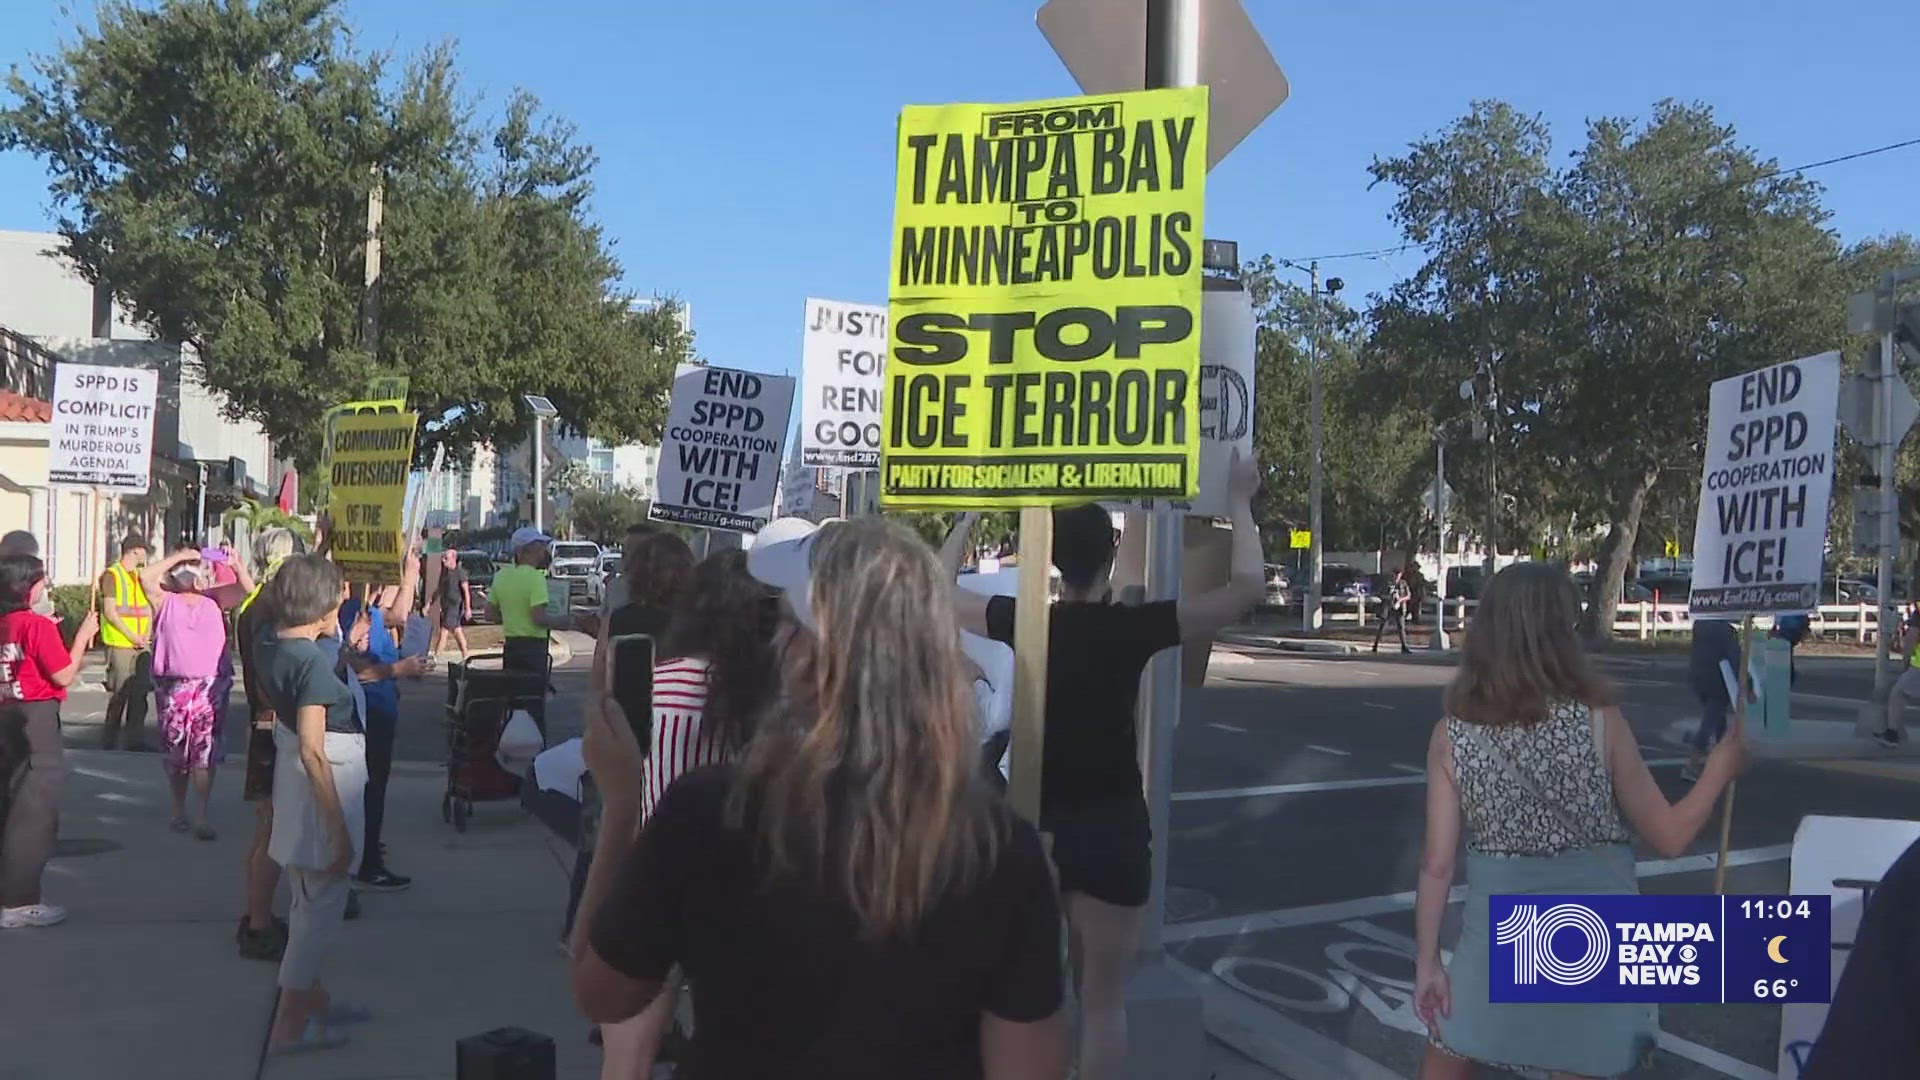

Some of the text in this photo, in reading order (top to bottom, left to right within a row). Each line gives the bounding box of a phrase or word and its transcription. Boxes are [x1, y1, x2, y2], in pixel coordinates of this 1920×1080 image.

[989, 107, 1114, 136] FROM
[908, 117, 1194, 205] TAMPA BAY
[1017, 200, 1078, 224] TO
[900, 211, 1192, 286] MINNEAPOLIS
[894, 305, 1193, 366] STOP
[75, 374, 138, 393] SPPD IS
[703, 370, 762, 400] END
[1740, 365, 1802, 413] END
[57, 399, 151, 420] COMPLICIT
[822, 385, 883, 413] REN
[890, 368, 1188, 449] ICE TERROR
[65, 423, 139, 438] IN TRUMP'S
[690, 400, 765, 432] SPPD
[59, 438, 142, 455] MURDEROUS
[335, 427, 413, 452] COMMUNITY
[670, 426, 778, 454] COOPERATION
[1727, 411, 1808, 462] SPPD
[69, 455, 129, 471] AGENDA!
[332, 459, 408, 487] OVERSIGHT
[678, 444, 760, 482] WITH
[890, 462, 1181, 488] PARTY FOR SOCIALISM & LIBERATION
[1707, 453, 1825, 491] COOPERATION
[682, 477, 742, 513] ICE!
[346, 504, 360, 527] OF
[1717, 484, 1807, 536] WITH
[1722, 537, 1787, 585] ICE!
